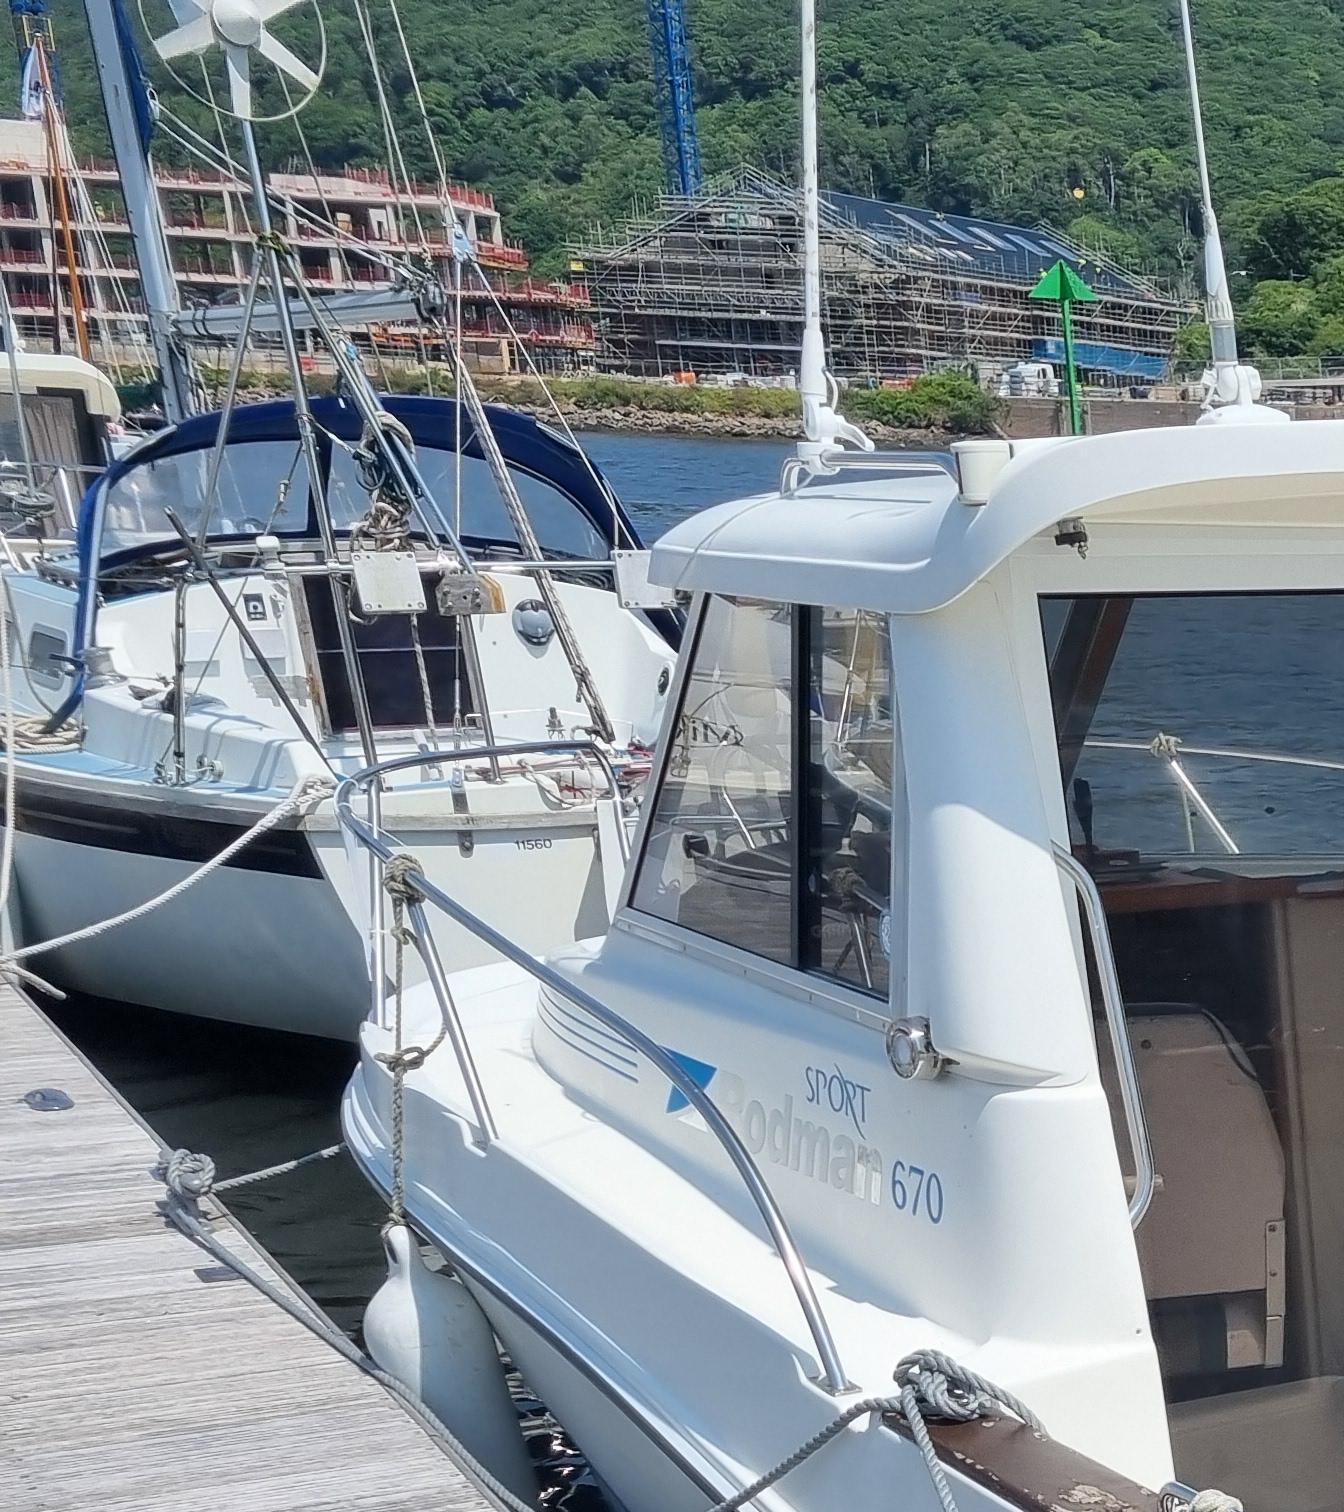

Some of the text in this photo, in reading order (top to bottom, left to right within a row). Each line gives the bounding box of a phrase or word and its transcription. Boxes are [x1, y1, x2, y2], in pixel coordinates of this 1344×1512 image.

[515, 838, 552, 850] 11560
[805, 1063, 871, 1140] SPORT
[891, 1160, 944, 1225] 670
